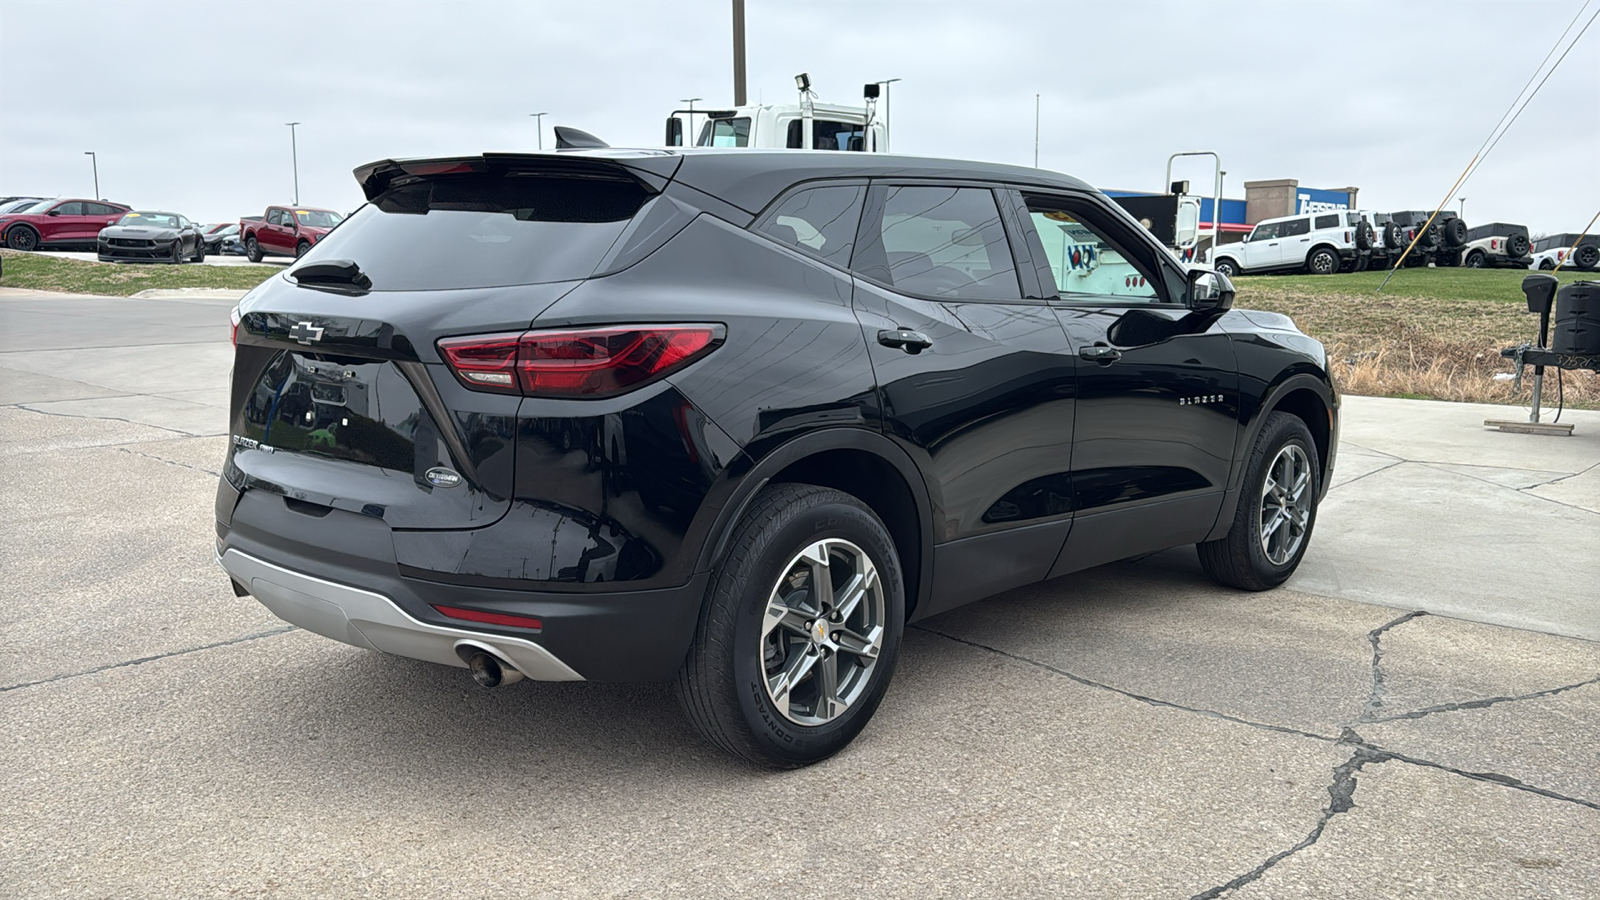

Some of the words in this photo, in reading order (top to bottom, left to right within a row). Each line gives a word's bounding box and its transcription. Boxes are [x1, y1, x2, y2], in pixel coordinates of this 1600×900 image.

[1179, 394, 1224, 406] BLAZER
[233, 434, 259, 450] BLAZER
[750, 681, 793, 744] CONTACT
